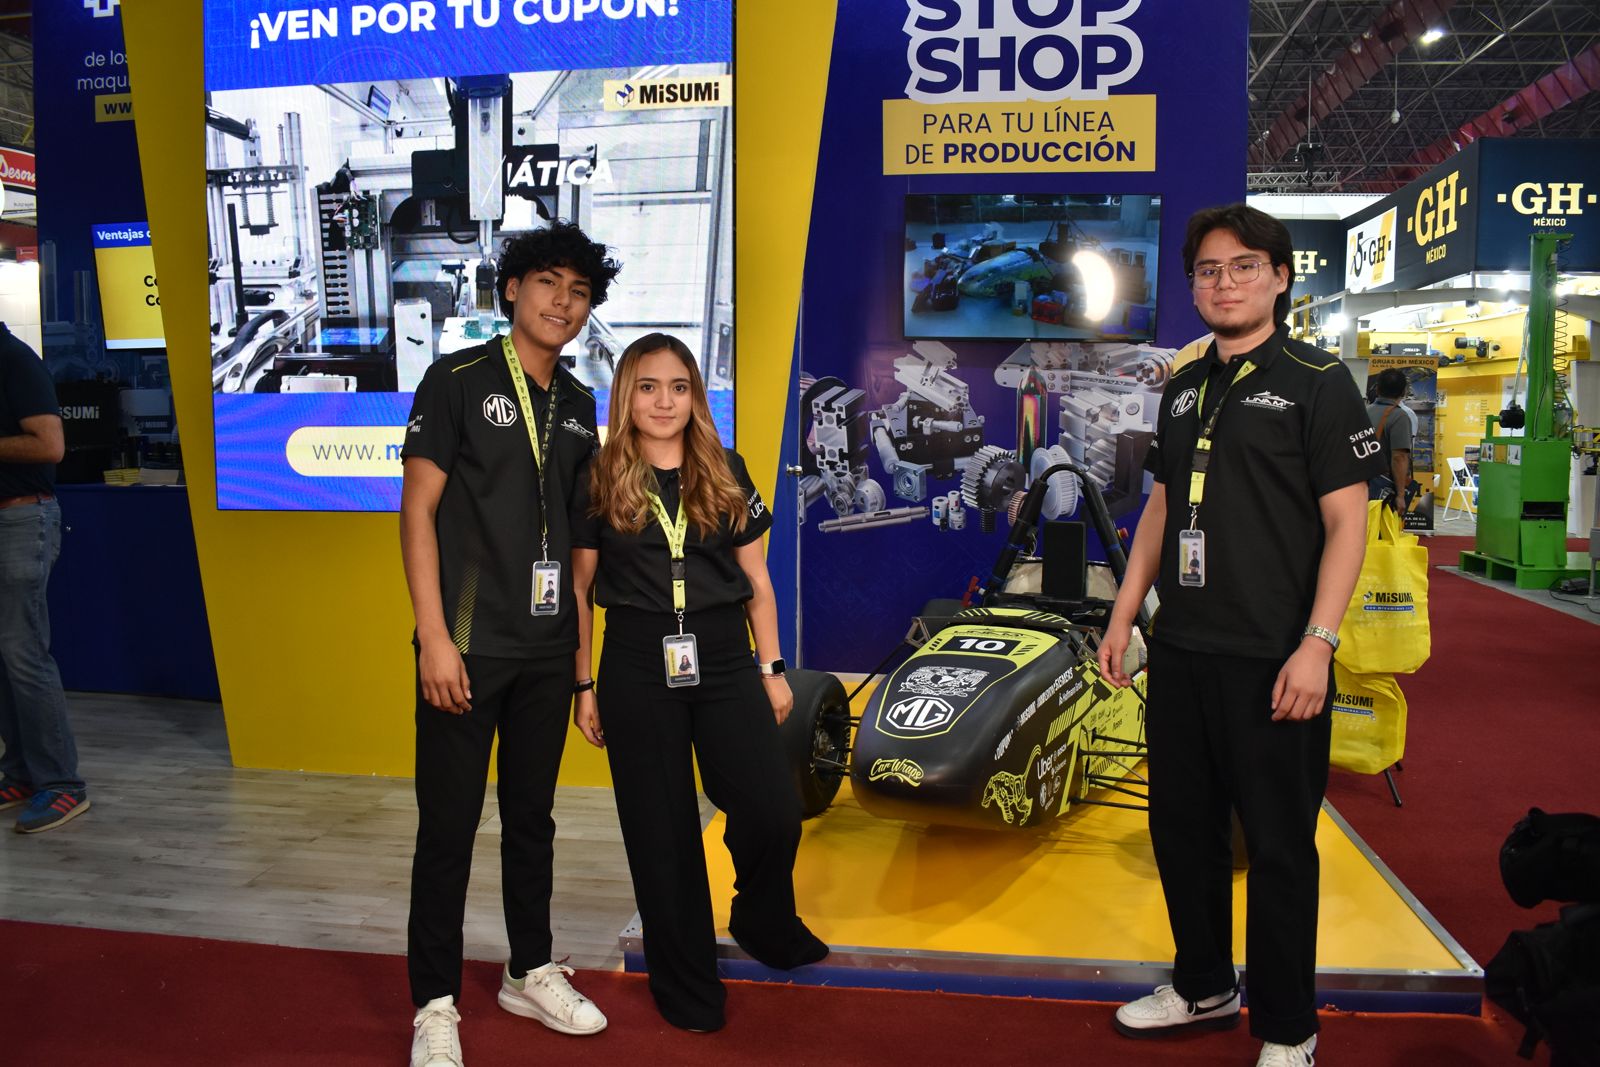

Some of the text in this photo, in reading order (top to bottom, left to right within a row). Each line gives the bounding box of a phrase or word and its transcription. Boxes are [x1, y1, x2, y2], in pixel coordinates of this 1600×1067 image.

[250, 9, 338, 49] ¡VEN
[352, 4, 436, 34] POR
[447, 0, 500, 29] TU
[84, 52, 106, 67] de
[914, 34, 1133, 94] SHOP
[923, 106, 1115, 134] PARA TU LÍNEA
[905, 134, 1136, 164] DE PRODUCCIÓN
[1414, 170, 1459, 246] GH
[1511, 182, 1584, 215] GH
[97, 229, 145, 241] Ventajas
[1533, 216, 1567, 227] MÉXICO
[1426, 244, 1447, 264] MÉXICO
[486, 396, 514, 425] MG
[1171, 389, 1197, 416] MG
[1376, 592, 1413, 603] MiSUMi
[959, 639, 1006, 652] 10
[891, 698, 949, 728] MG
[871, 758, 924, 780] Car Wraps
[1036, 753, 1054, 780] Uber
